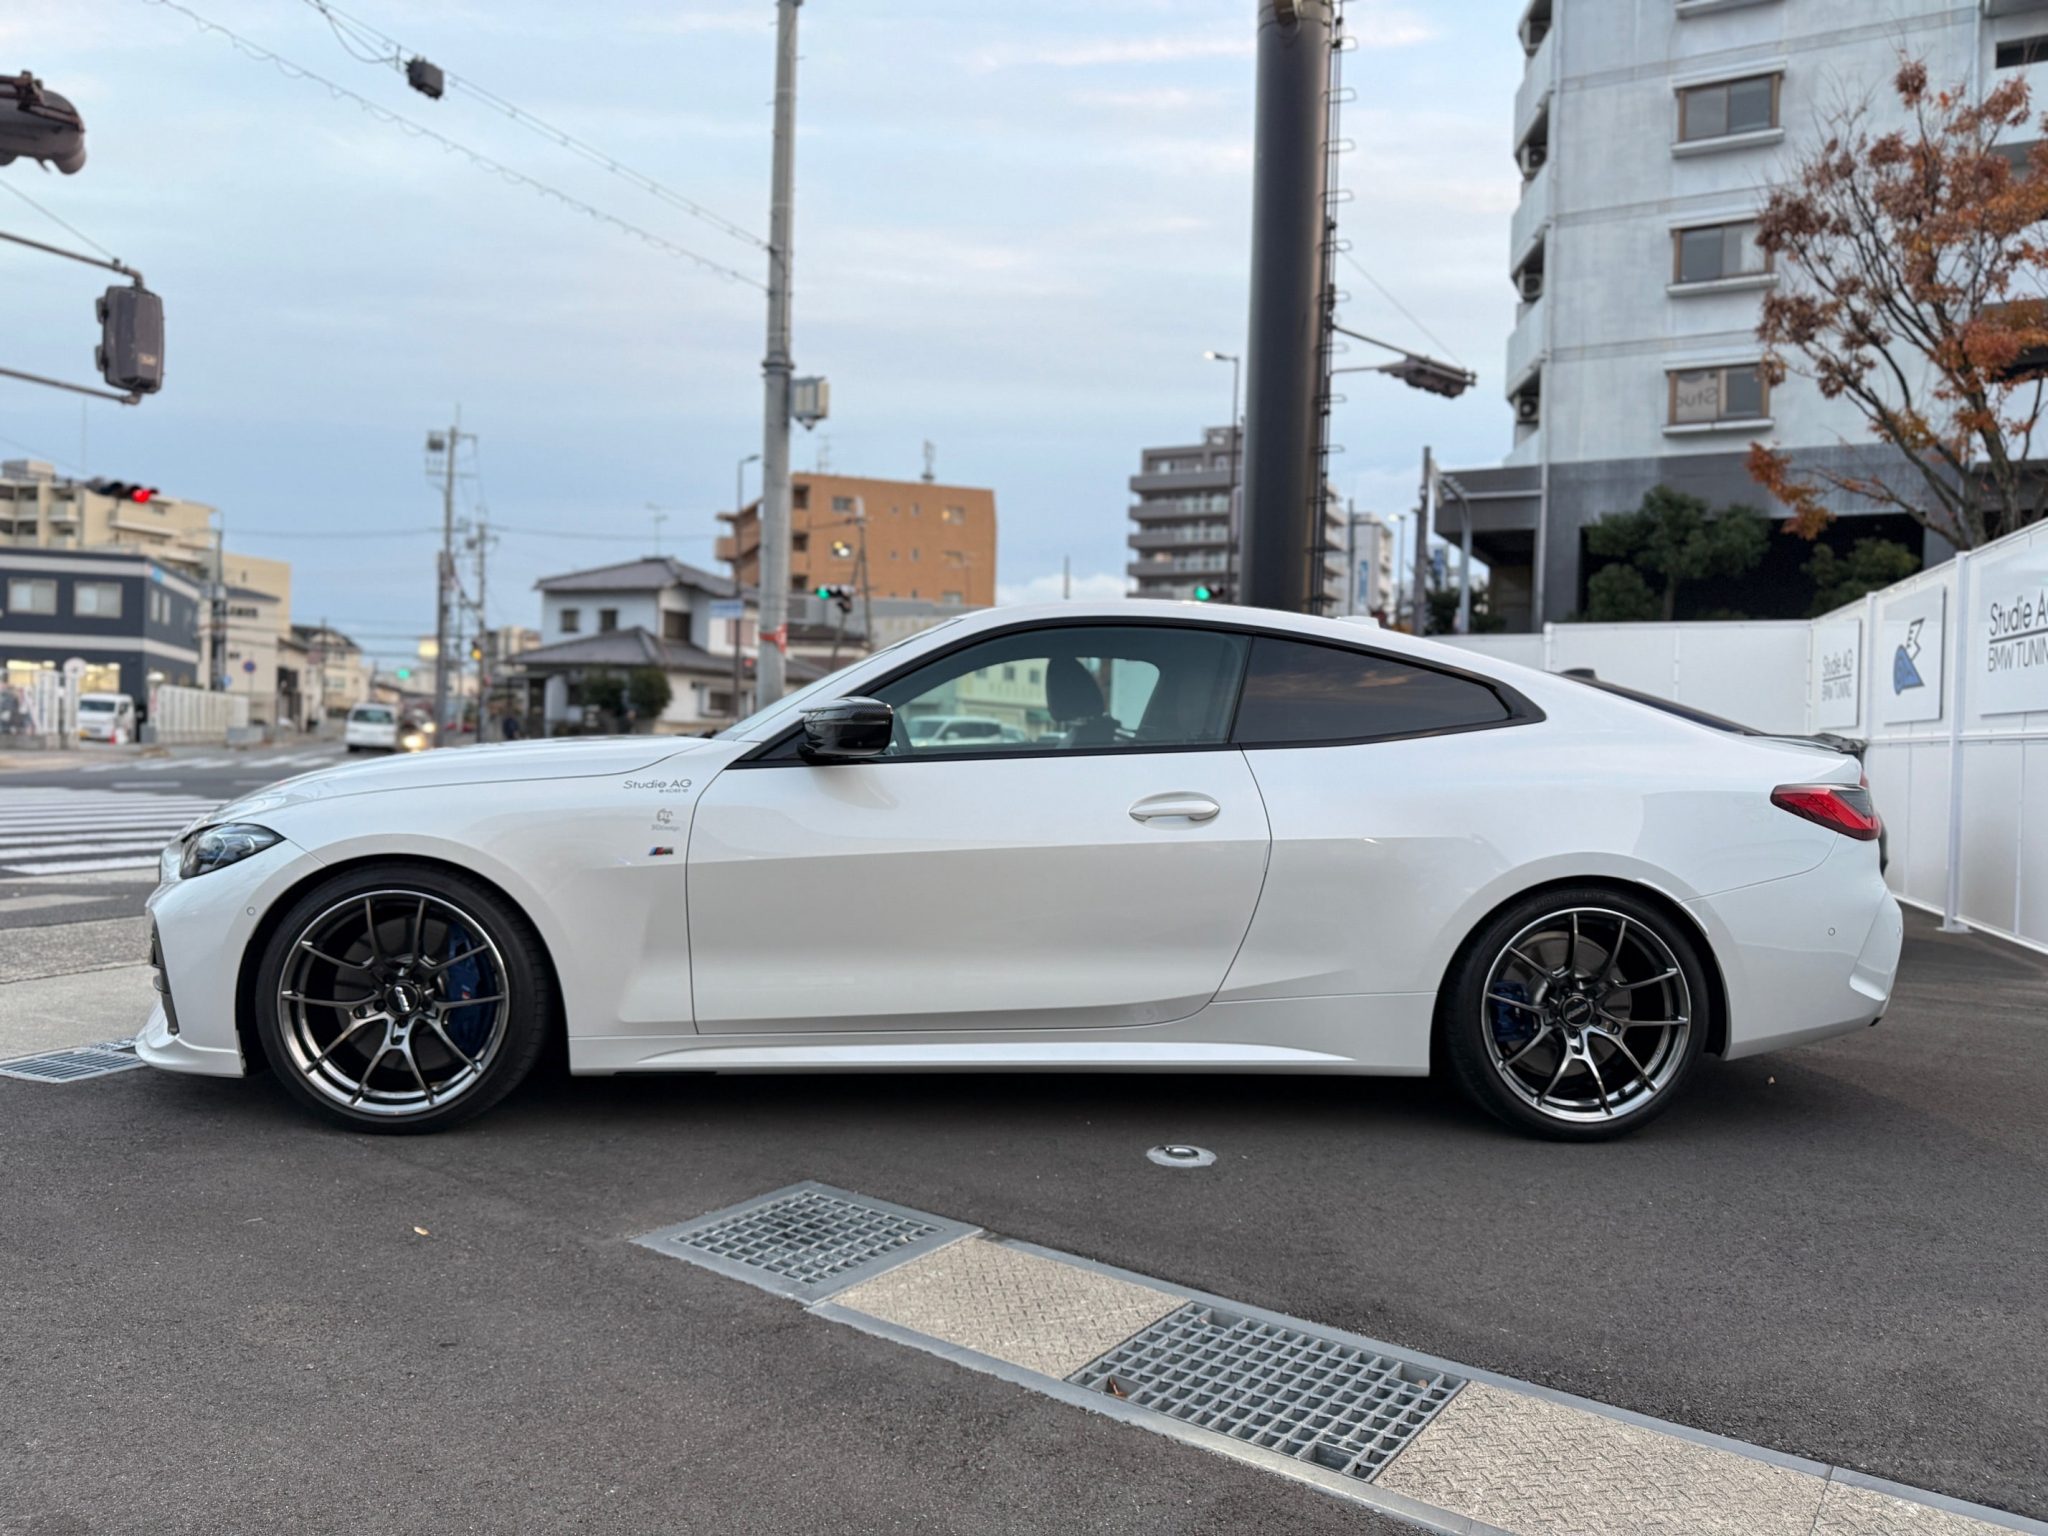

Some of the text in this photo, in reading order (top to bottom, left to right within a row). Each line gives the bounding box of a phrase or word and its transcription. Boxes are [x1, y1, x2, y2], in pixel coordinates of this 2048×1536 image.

[1989, 588, 2048, 636] Studie A
[1988, 642, 2014, 672] BMW
[623, 779, 667, 789] Studie
